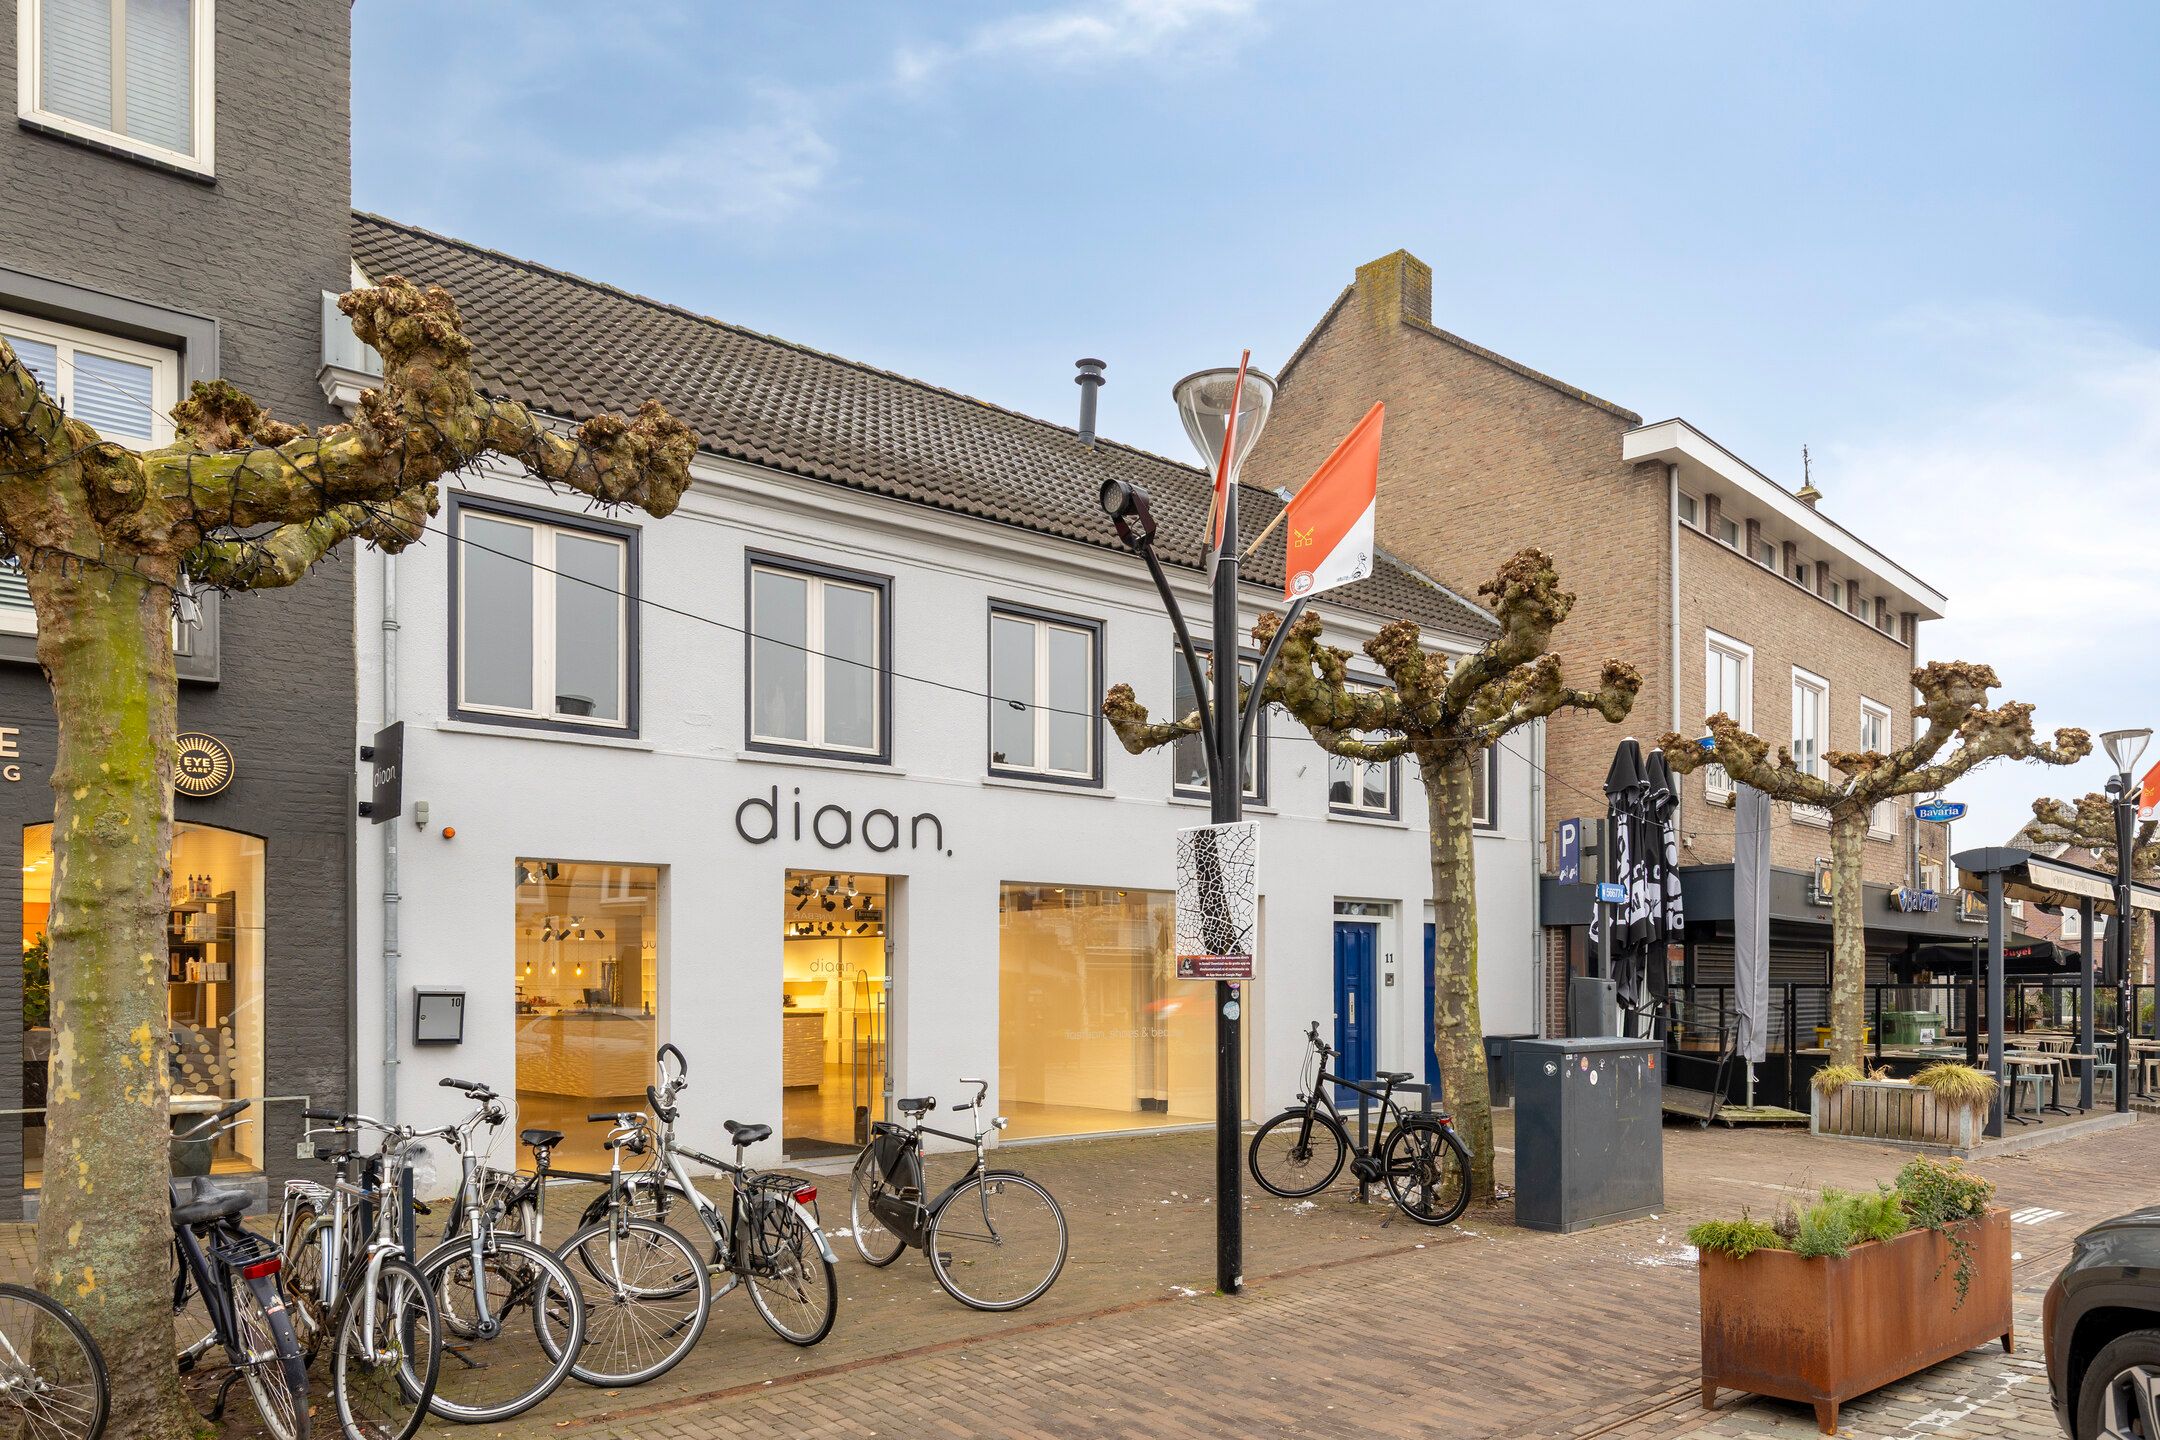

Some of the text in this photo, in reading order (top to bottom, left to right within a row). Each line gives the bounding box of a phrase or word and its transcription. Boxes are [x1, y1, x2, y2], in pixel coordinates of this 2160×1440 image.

[183, 756, 211, 767] EYE
[1920, 806, 1960, 818] Bavaria
[735, 784, 953, 858] diaan.
[1562, 823, 1576, 858] P
[1907, 887, 1939, 913] Bavaria
[1384, 953, 1394, 964] 11
[451, 997, 461, 1007] 10
[1141, 1026, 1149, 1038] &
